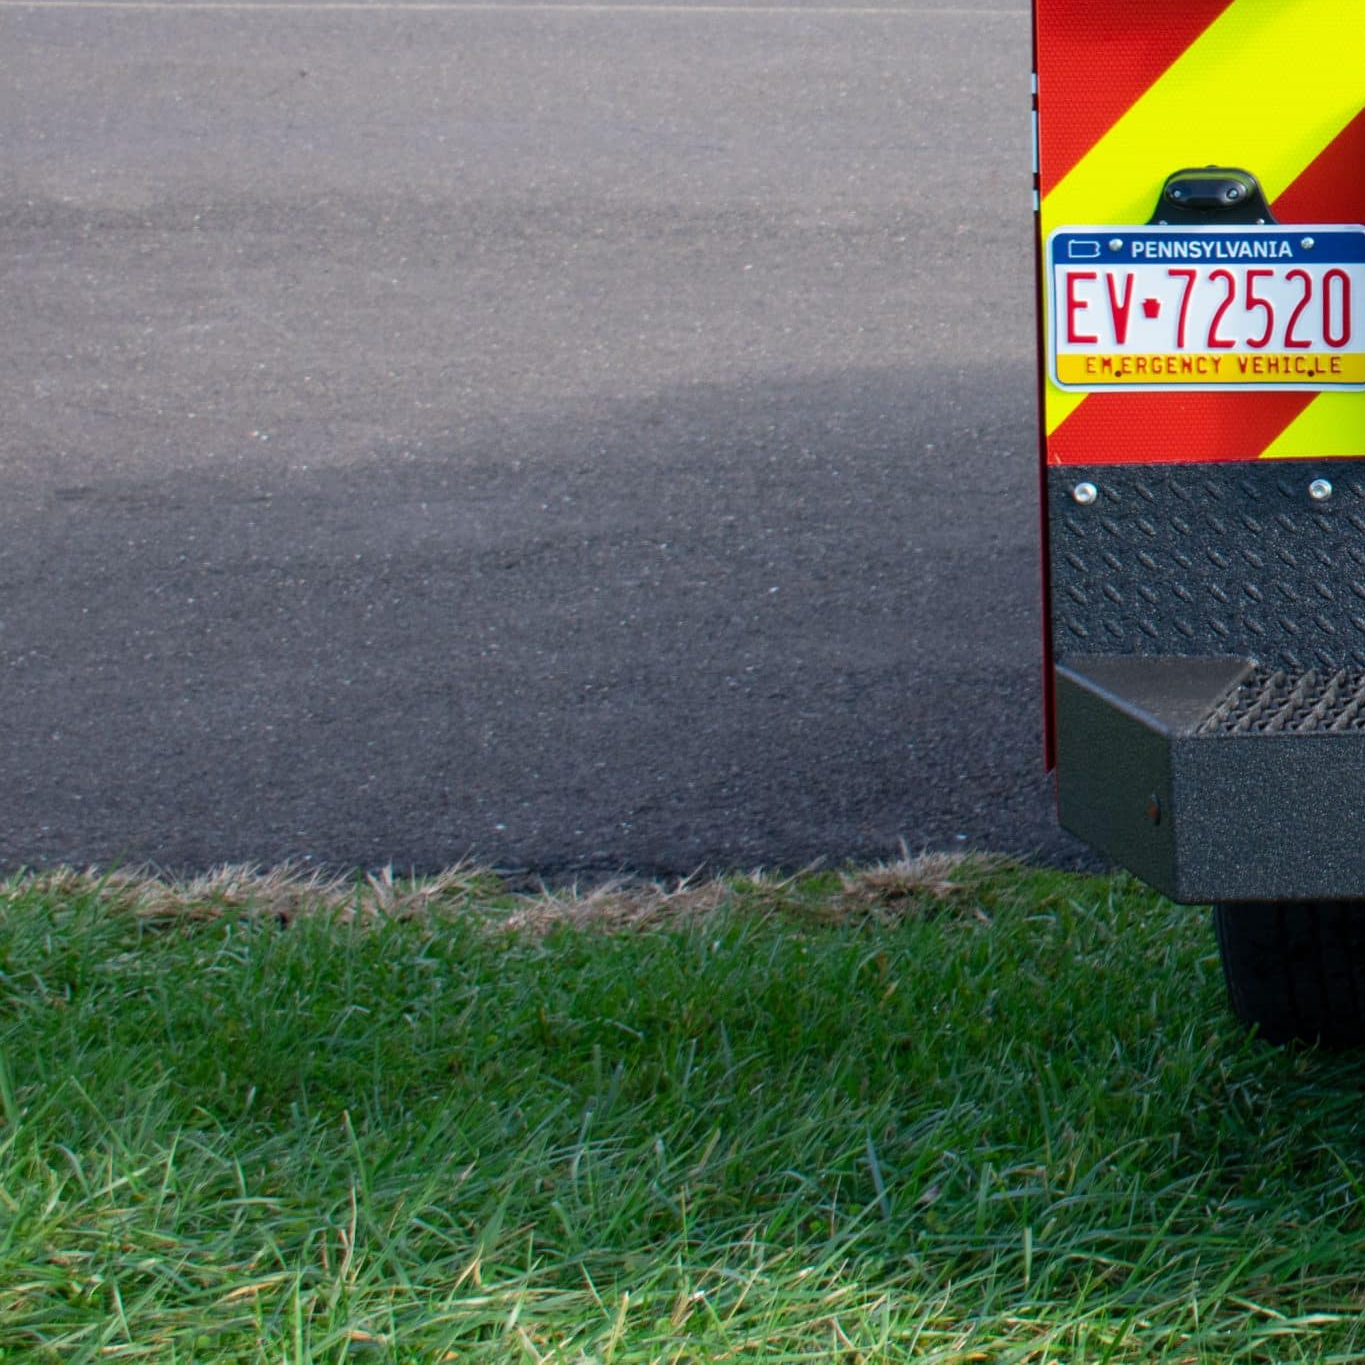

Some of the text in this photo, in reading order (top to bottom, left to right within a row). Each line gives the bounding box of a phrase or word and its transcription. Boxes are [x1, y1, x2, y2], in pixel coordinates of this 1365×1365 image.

[1131, 240, 1293, 259] PENNSYLVANIA
[1086, 356, 1343, 375] EMERGENCY VEHICLE
